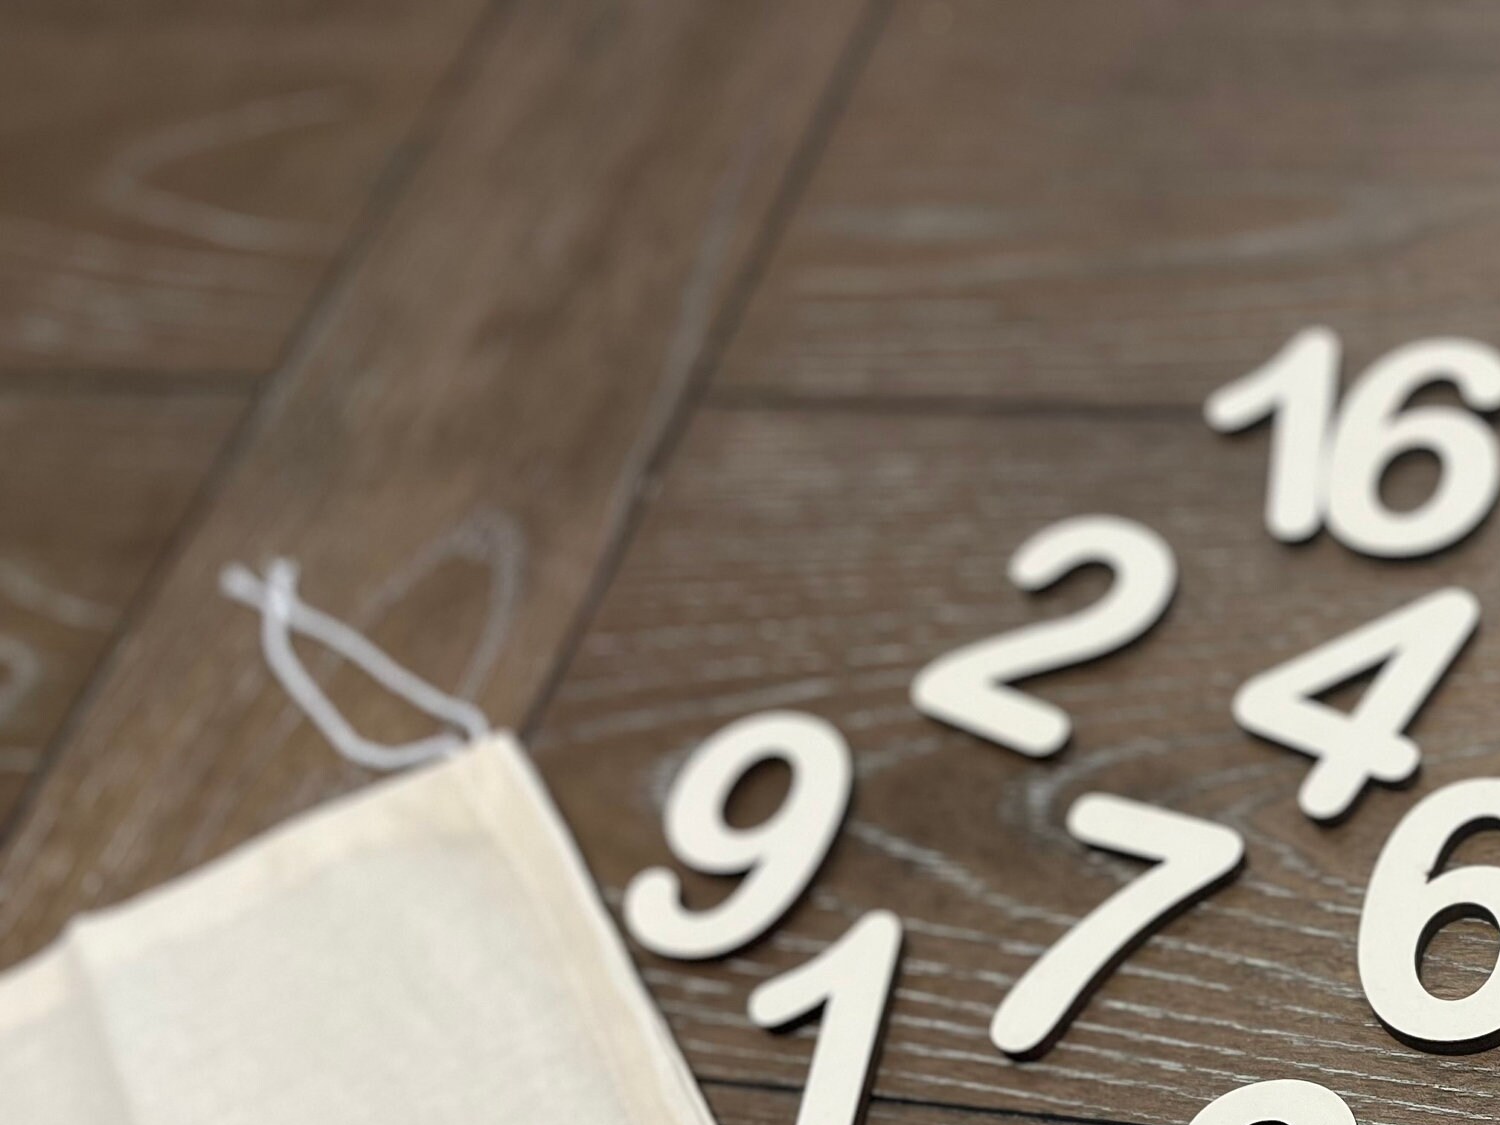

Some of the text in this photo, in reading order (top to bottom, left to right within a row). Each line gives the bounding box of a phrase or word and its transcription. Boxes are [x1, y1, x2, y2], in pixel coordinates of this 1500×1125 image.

[911, 515, 1176, 756] 2
[1233, 587, 1480, 818] 4
[624, 712, 852, 959] 9
[990, 793, 1244, 1055] 7
